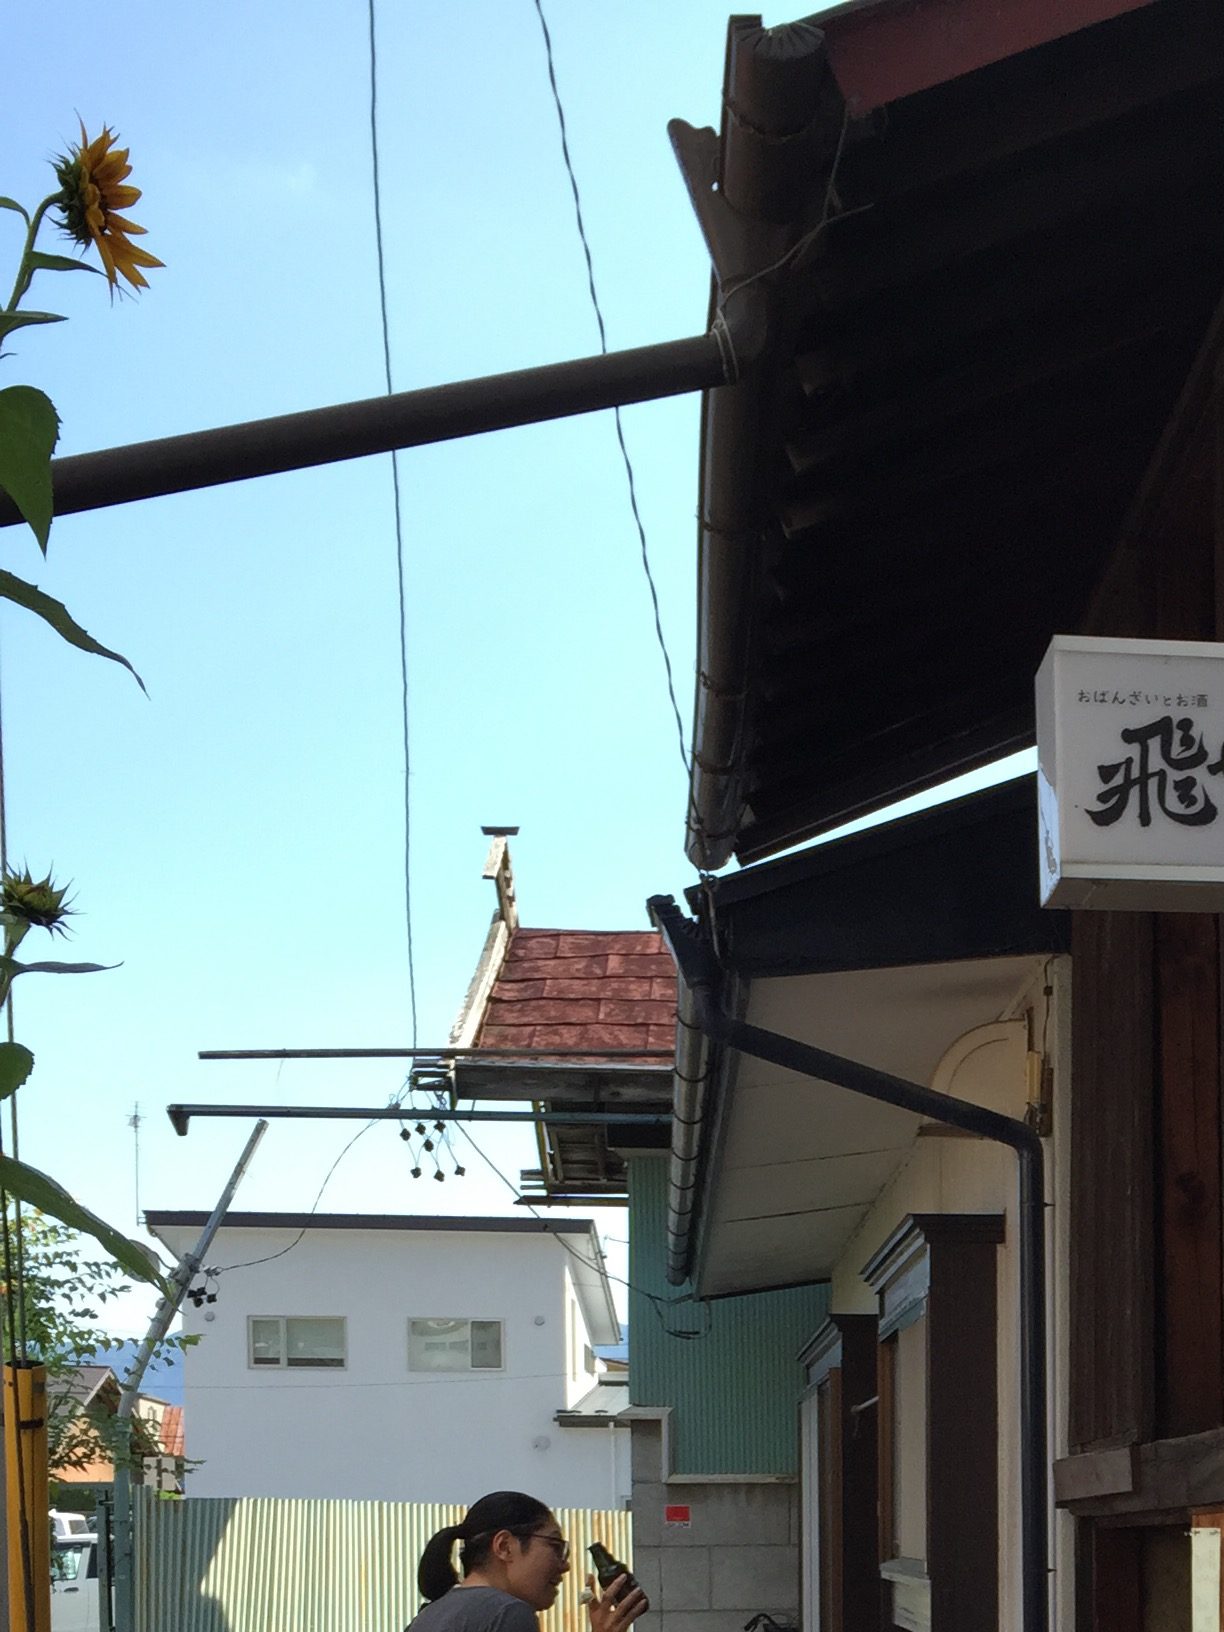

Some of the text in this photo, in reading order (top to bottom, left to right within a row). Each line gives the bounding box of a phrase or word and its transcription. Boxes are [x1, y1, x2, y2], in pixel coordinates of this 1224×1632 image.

[1077, 688, 1209, 708] おばんざいとお酒
